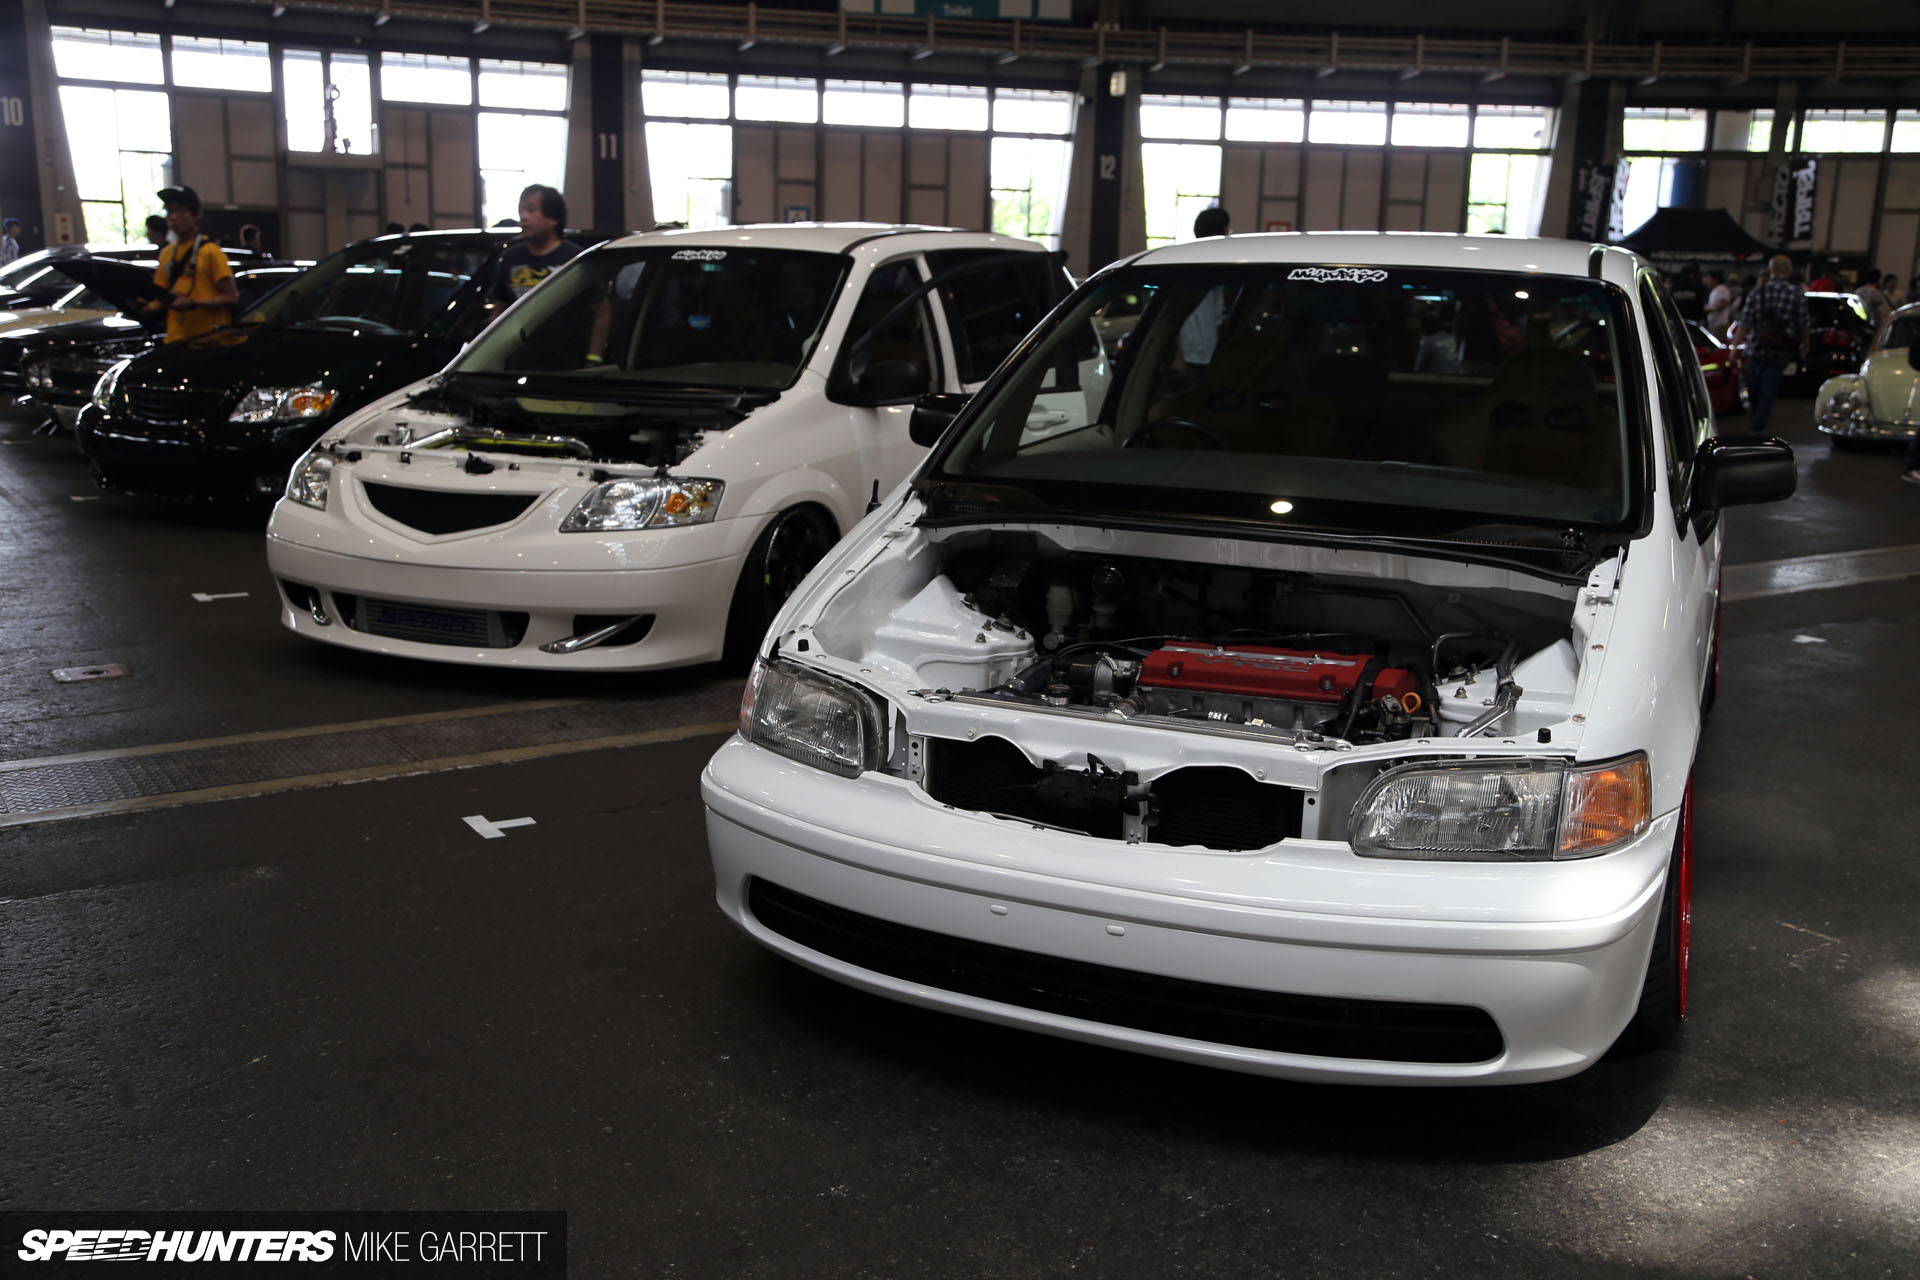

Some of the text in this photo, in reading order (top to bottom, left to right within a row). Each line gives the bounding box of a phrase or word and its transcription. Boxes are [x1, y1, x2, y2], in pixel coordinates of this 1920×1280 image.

[0, 96, 24, 127] 10
[598, 132, 617, 160] 11
[1099, 154, 1116, 180] 12
